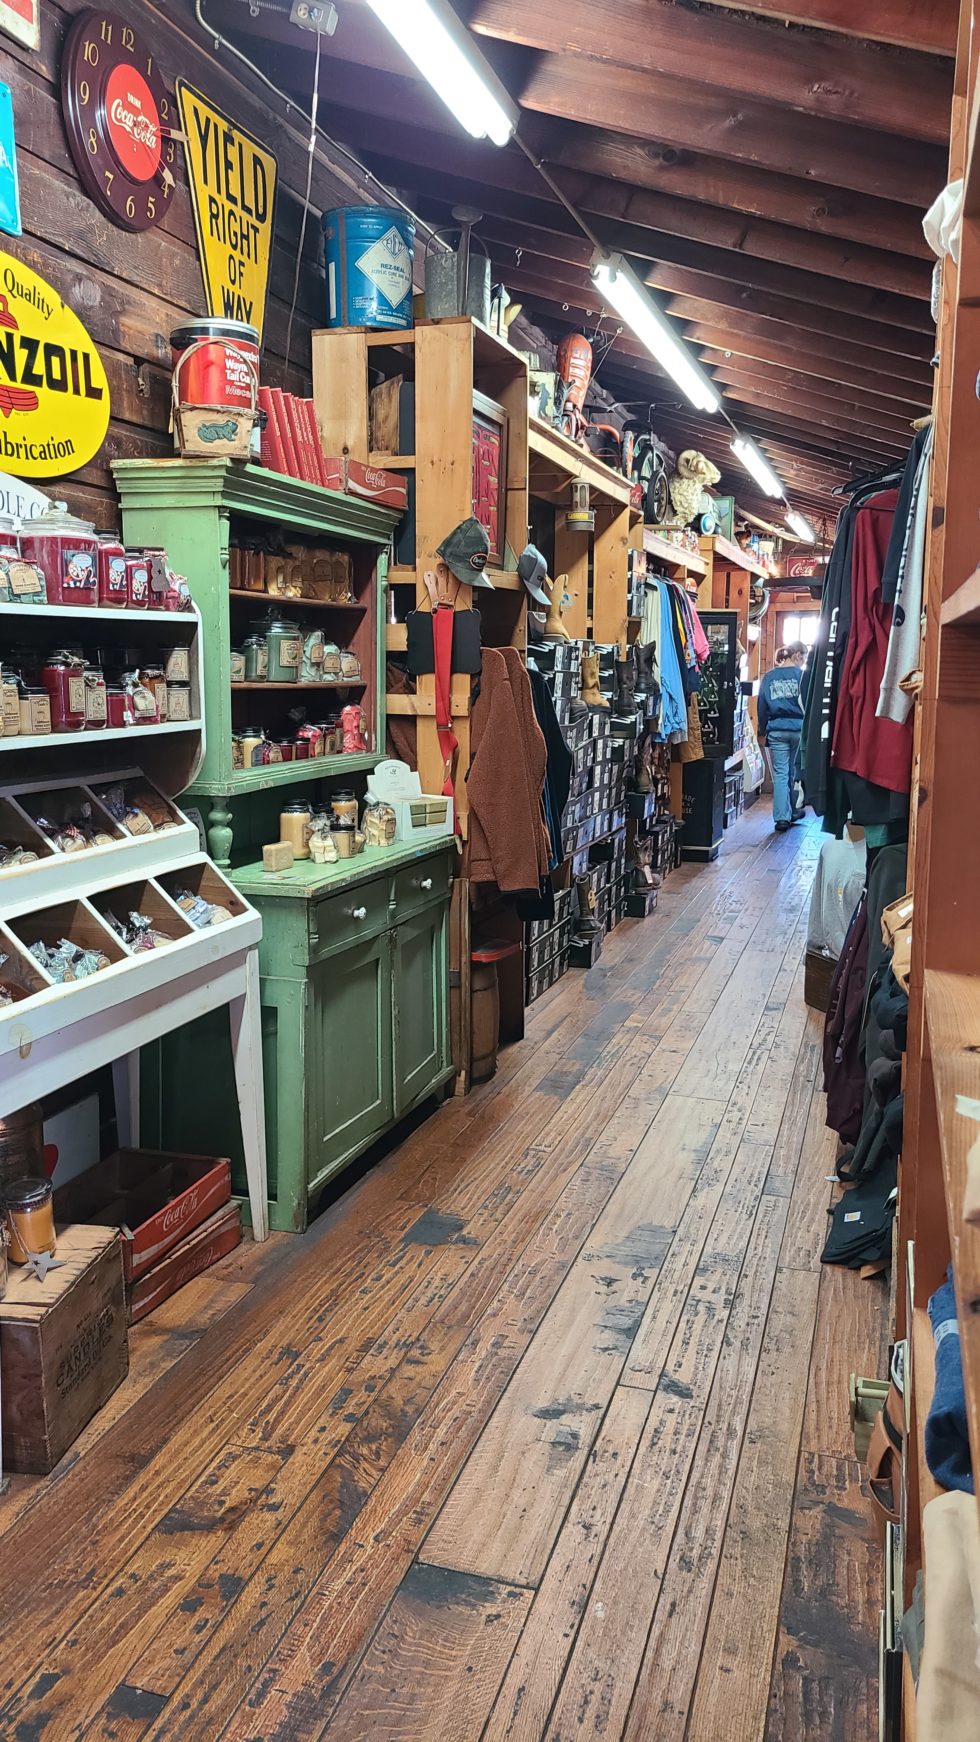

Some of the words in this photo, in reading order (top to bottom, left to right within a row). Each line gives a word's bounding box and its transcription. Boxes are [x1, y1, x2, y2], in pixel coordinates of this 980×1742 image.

[100, 20, 112, 46] 11
[121, 26, 135, 52] 12
[83, 40, 99, 66] 10
[147, 58, 152, 76] 1
[80, 81, 90, 105] 9
[161, 98, 169, 120] 2
[111, 98, 158, 149] Coca-Cola
[88, 128, 97, 154] 8
[166, 141, 175, 163] 3
[193, 105, 267, 224] YIELD
[104, 170, 114, 196] 7
[160, 178, 171, 199] 4
[126, 195, 136, 218] 6
[146, 196, 156, 219] 5
[208, 194, 260, 264] RIGHT
[228, 254, 245, 289] OF
[3, 268, 54, 321] Quality
[221, 285, 253, 324] WAY
[0, 430, 75, 460] brication
